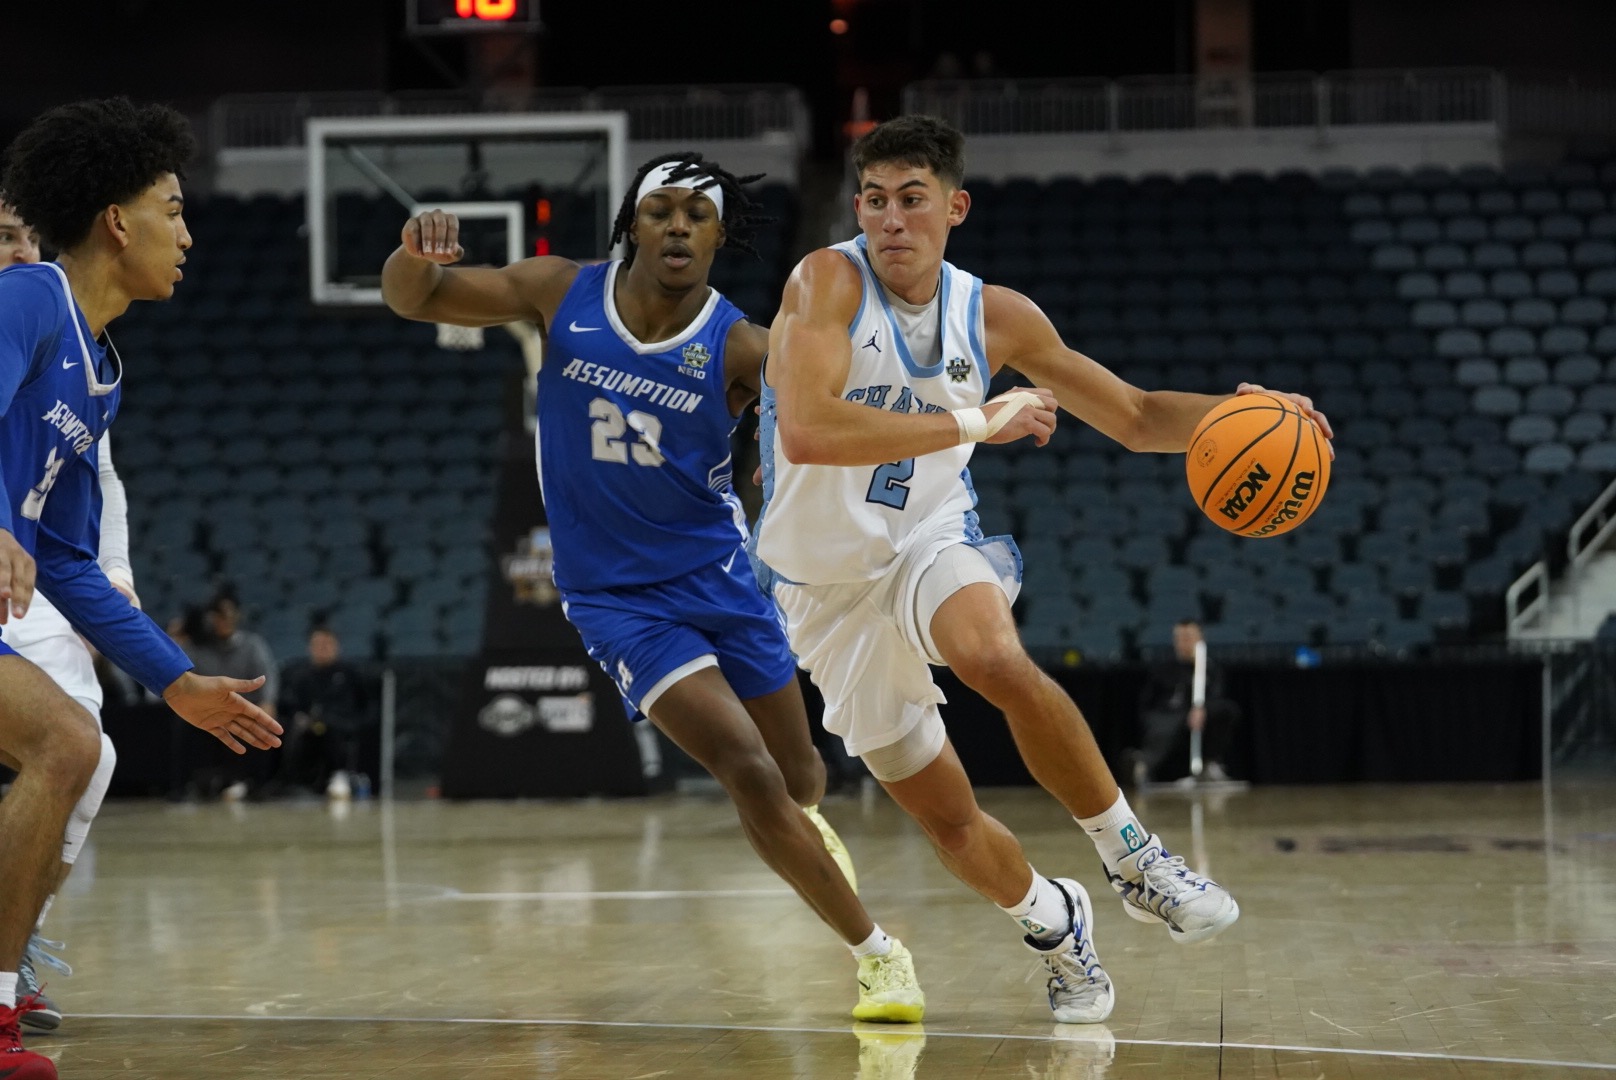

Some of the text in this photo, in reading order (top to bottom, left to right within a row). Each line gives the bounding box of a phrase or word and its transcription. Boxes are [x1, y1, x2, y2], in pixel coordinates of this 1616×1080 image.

[562, 358, 703, 414] ASSUMPTION
[678, 365, 706, 379] NE10
[588, 398, 666, 467] 23
[865, 457, 915, 511] 2
[1219, 463, 1271, 520] NCAA
[1248, 470, 1315, 536] Wilson
